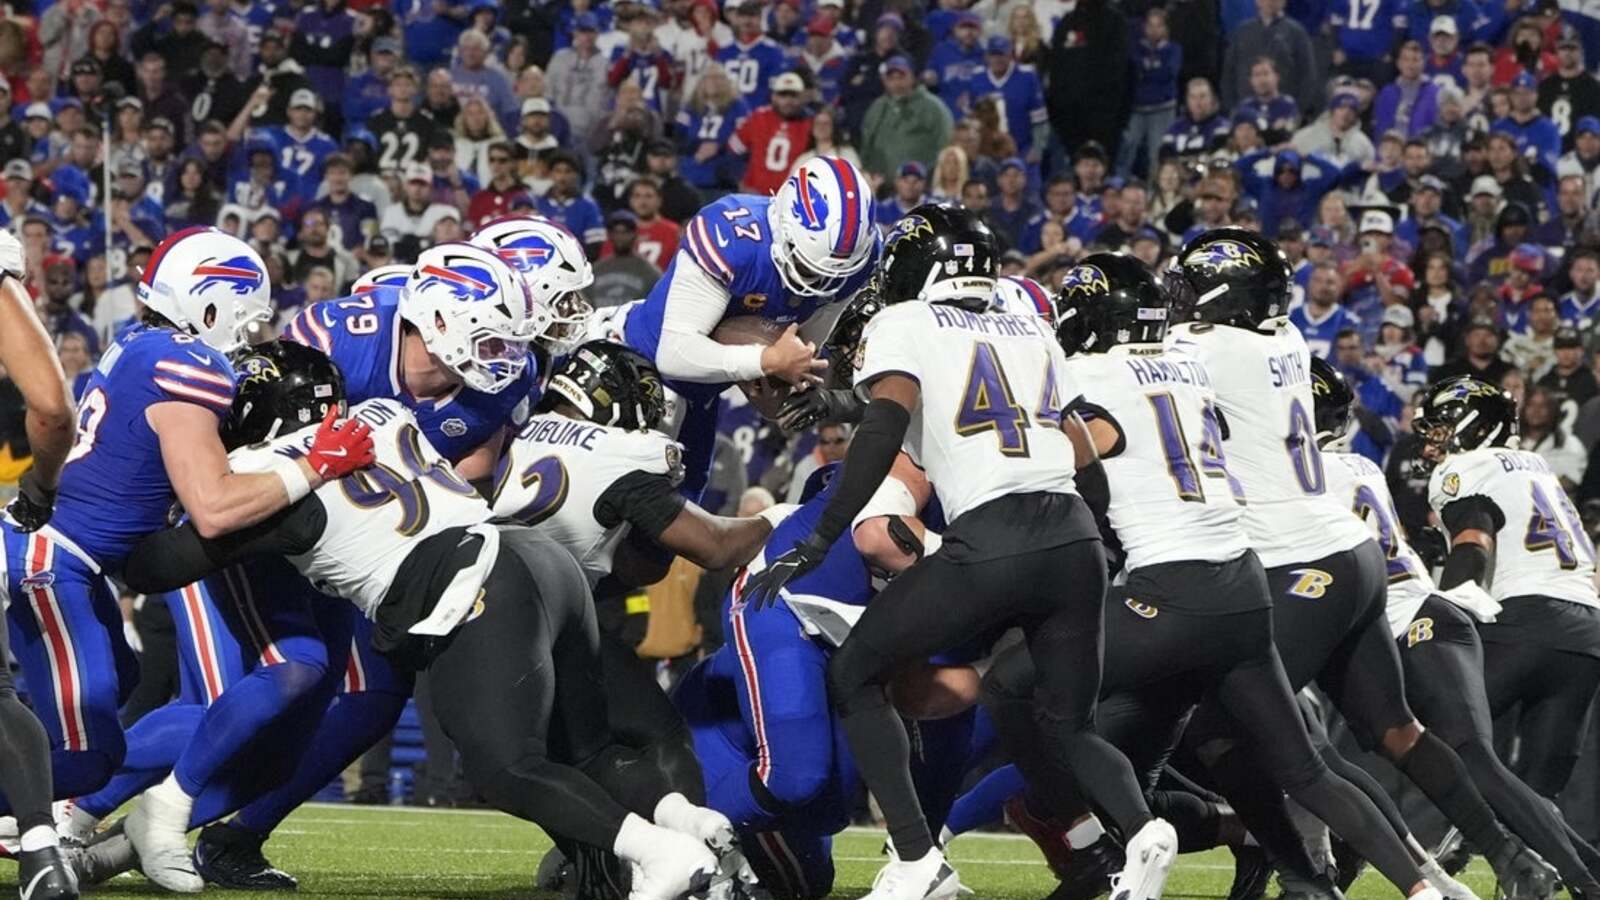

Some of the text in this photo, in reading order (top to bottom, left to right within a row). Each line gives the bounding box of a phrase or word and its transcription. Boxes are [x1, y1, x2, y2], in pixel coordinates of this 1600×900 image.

[1348, 0, 1381, 29] 17
[281, 146, 315, 175] 17
[379, 131, 419, 169] 22
[765, 137, 790, 171] 0
[723, 207, 761, 243] 17
[964, 256, 991, 273] 44
[338, 294, 379, 336] 79
[929, 303, 1046, 338] HUMPHREY
[565, 362, 591, 385] 92
[1268, 351, 1305, 388] SMITH
[65, 386, 108, 464] 9
[1146, 390, 1247, 506] 14
[495, 453, 570, 527] 2
[1288, 567, 1333, 599] B
[1408, 617, 1434, 647] B
